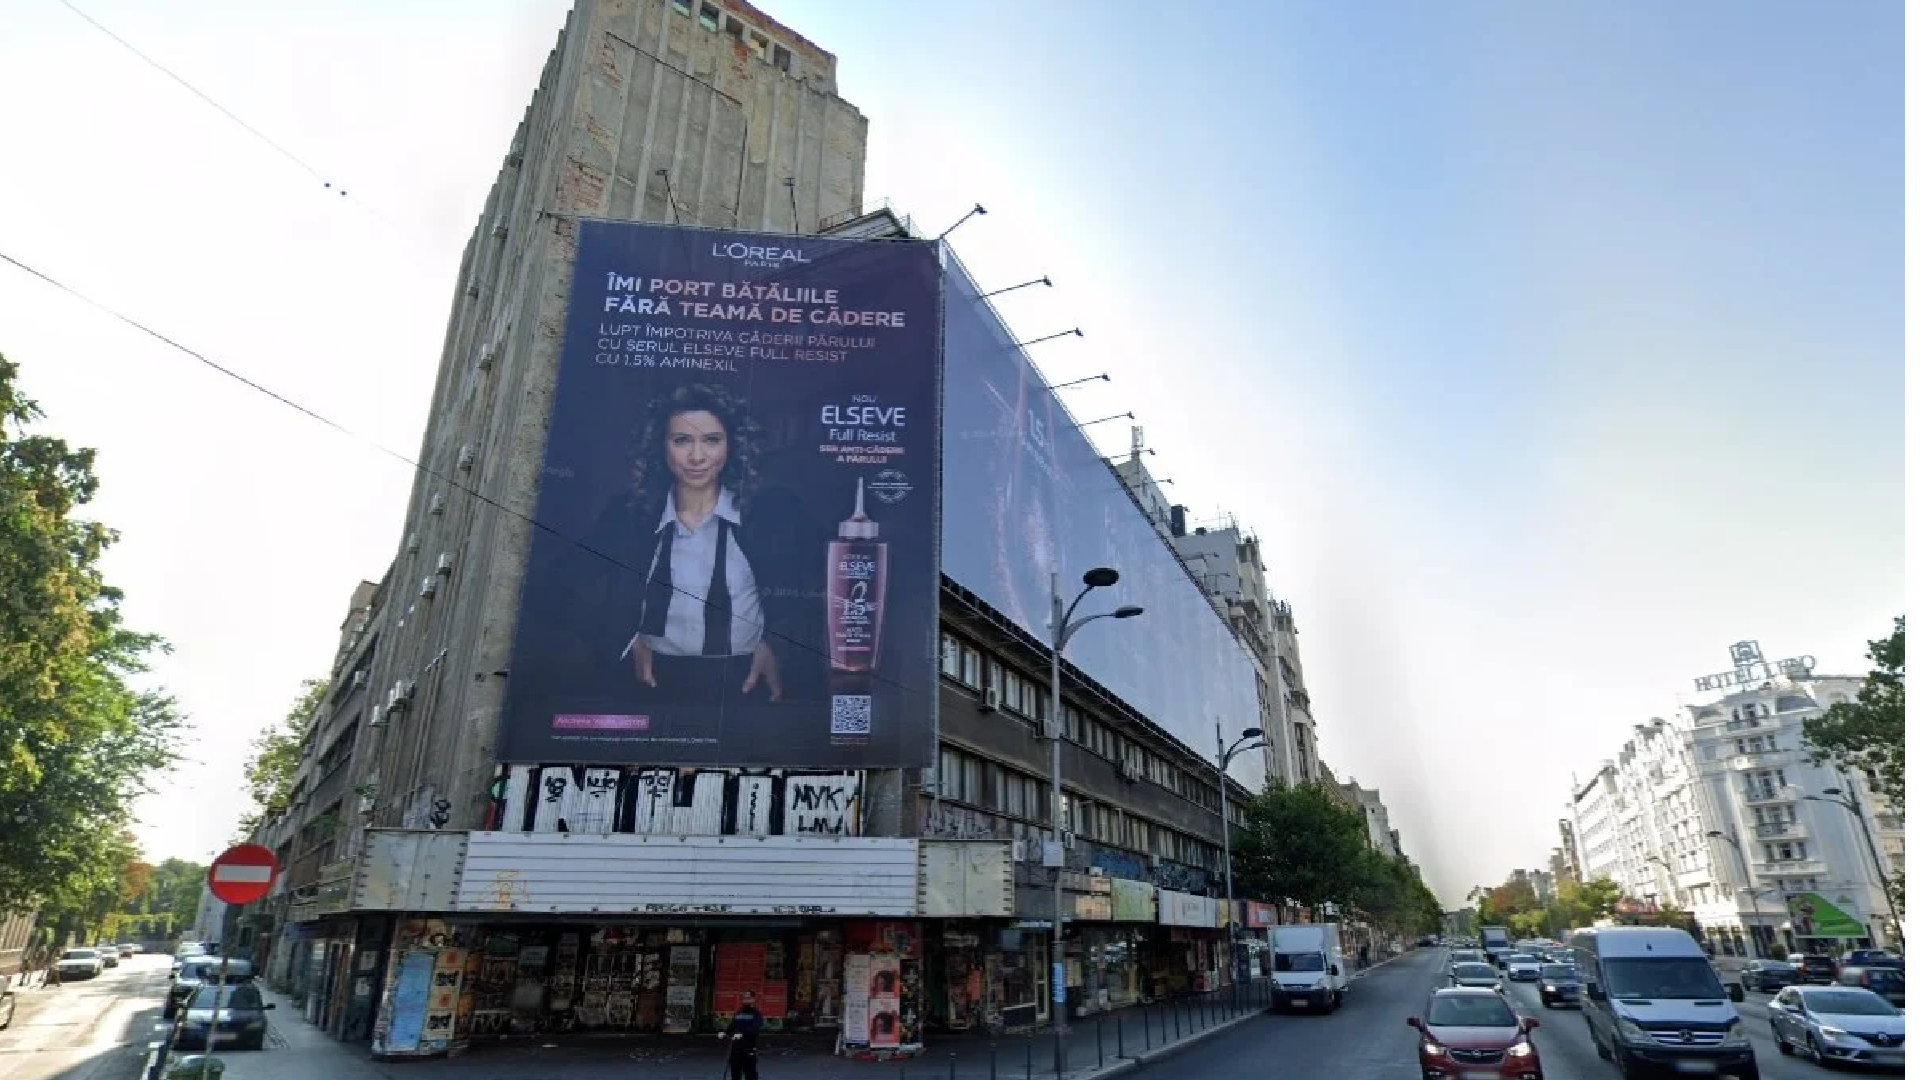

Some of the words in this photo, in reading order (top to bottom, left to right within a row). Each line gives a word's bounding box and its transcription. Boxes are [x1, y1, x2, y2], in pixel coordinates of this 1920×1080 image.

[606, 271, 642, 292] ÎMI
[650, 278, 715, 297] PORT
[604, 294, 671, 315] FĂRĂ
[678, 302, 764, 321] TEAMĂ
[771, 306, 804, 324] DE
[810, 305, 906, 328] CĂDERE
[600, 322, 641, 337] LUPT
[646, 322, 733, 342] ÎMPOTRIVA
[597, 338, 621, 350] CU
[627, 338, 679, 353] SERUL
[683, 342, 746, 358] ELSEVE
[750, 346, 789, 360] FULL
[794, 348, 848, 362] RESIST
[595, 352, 620, 364] CU
[660, 356, 738, 372] AMINEXIL
[821, 404, 906, 427] ELSEVE
[829, 428, 854, 441] Full
[858, 428, 898, 443] Resist
[1694, 662, 1766, 692] HOTEL
